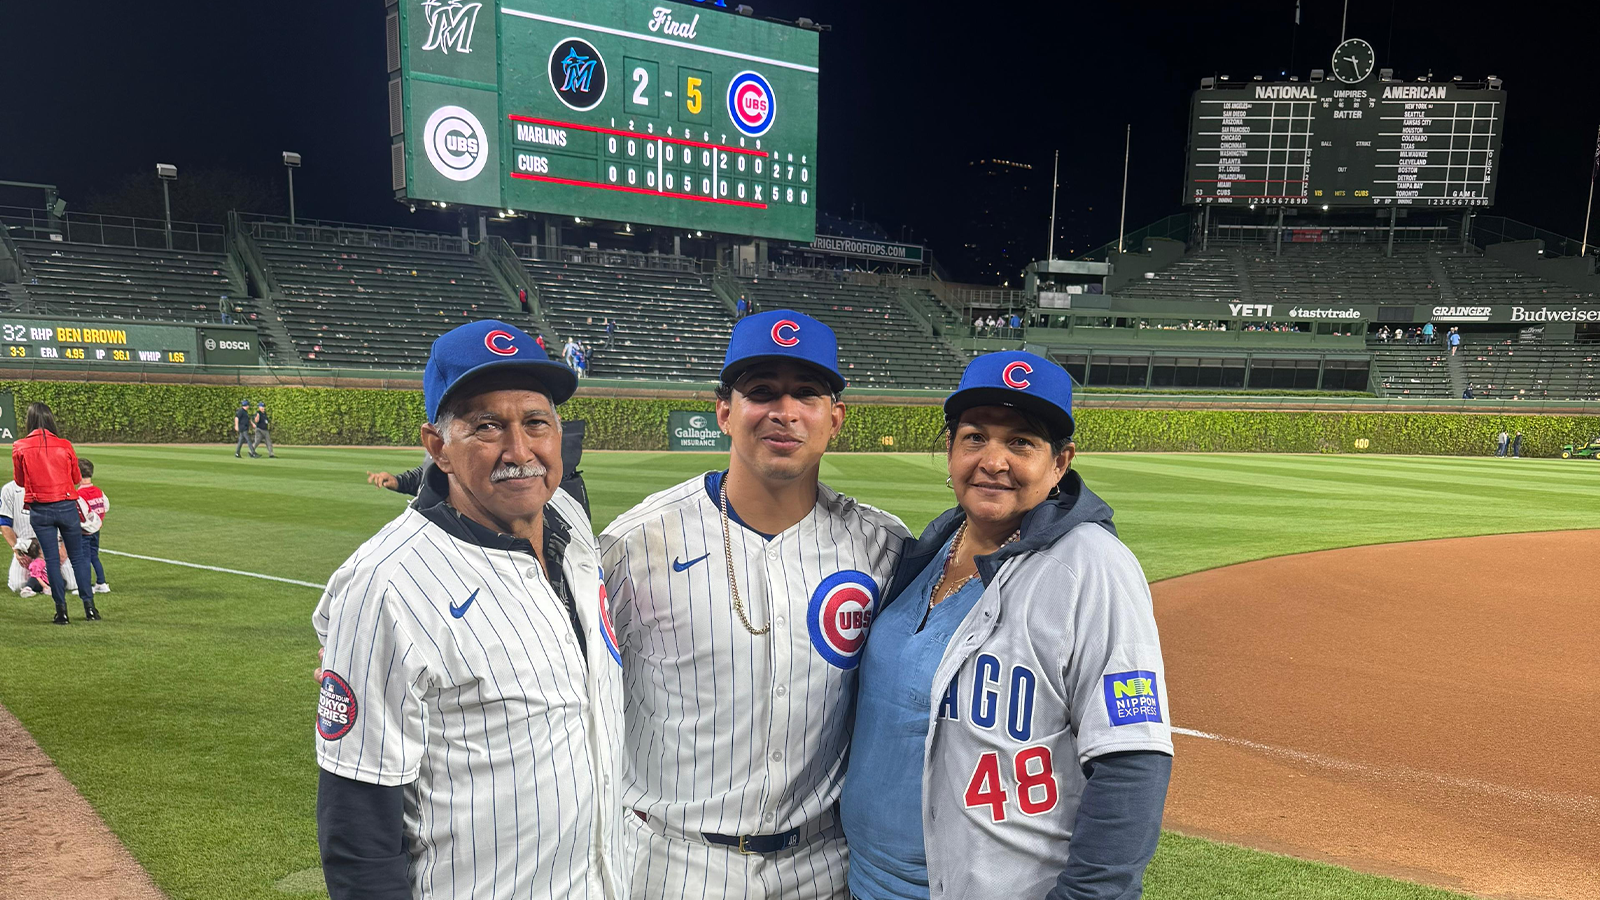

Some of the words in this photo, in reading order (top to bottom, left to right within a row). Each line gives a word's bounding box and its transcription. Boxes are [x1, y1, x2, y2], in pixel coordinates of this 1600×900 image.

[648, 6, 700, 39] Final
[632, 67, 649, 106] 2
[686, 76, 702, 114] 5
[1255, 86, 1318, 99] NATIONAL
[1382, 86, 1446, 99] AMERICAN
[1334, 110, 1362, 119] BATTER
[611, 117, 615, 128] 1
[629, 120, 634, 131] 2
[647, 123, 653, 134] 3
[667, 126, 672, 136] 4
[685, 129, 690, 139] 5
[721, 134, 726, 144] 7
[517, 124, 567, 147] MARLINS
[608, 137, 616, 154] 0
[628, 140, 636, 156] 0
[647, 142, 655, 159] 0
[666, 145, 673, 162] 0
[684, 148, 691, 164] 0
[702, 150, 710, 166] 0
[720, 153, 727, 169] 2
[738, 156, 745, 172] 0
[754, 158, 762, 174] 0
[773, 164, 780, 178] 2
[787, 166, 794, 180] 7
[801, 168, 808, 182] 0
[518, 154, 548, 173] CUBS
[609, 166, 617, 182] 0
[628, 168, 636, 184] 0
[647, 171, 655, 187] 0
[666, 173, 673, 189] 0
[684, 176, 691, 191] 5
[703, 178, 710, 194] 0
[720, 180, 728, 196] 0
[738, 183, 745, 198] 0
[754, 184, 762, 200] X
[773, 186, 779, 200] 5
[787, 188, 793, 202] 8
[801, 190, 808, 204] 0
[1228, 304, 1274, 317] YETI
[1432, 306, 1492, 316] GRAINGER
[3, 324, 27, 342] 32
[30, 327, 53, 341] RHP
[56, 327, 82, 342] BEN
[83, 328, 127, 345] BROWN
[771, 319, 800, 347] C
[220, 340, 250, 350] BOSCH
[484, 330, 518, 356] C
[10, 346, 26, 357] 3-3
[40, 347, 58, 358] ERA
[65, 348, 84, 359] 4.95
[96, 349, 105, 360] IP
[113, 350, 130, 361] 36.1
[138, 351, 161, 362] WHIP
[168, 352, 185, 363] 1.65
[1003, 360, 1034, 390] C
[675, 428, 721, 439] Gallagher
[1354, 438, 1369, 448] 400
[320, 693, 348, 714] OKYO
[336, 694, 350, 703] TOUR
[1116, 697, 1156, 709] NIPPON
[1118, 706, 1157, 718] EXPRESS
[963, 745, 1060, 824] 48
